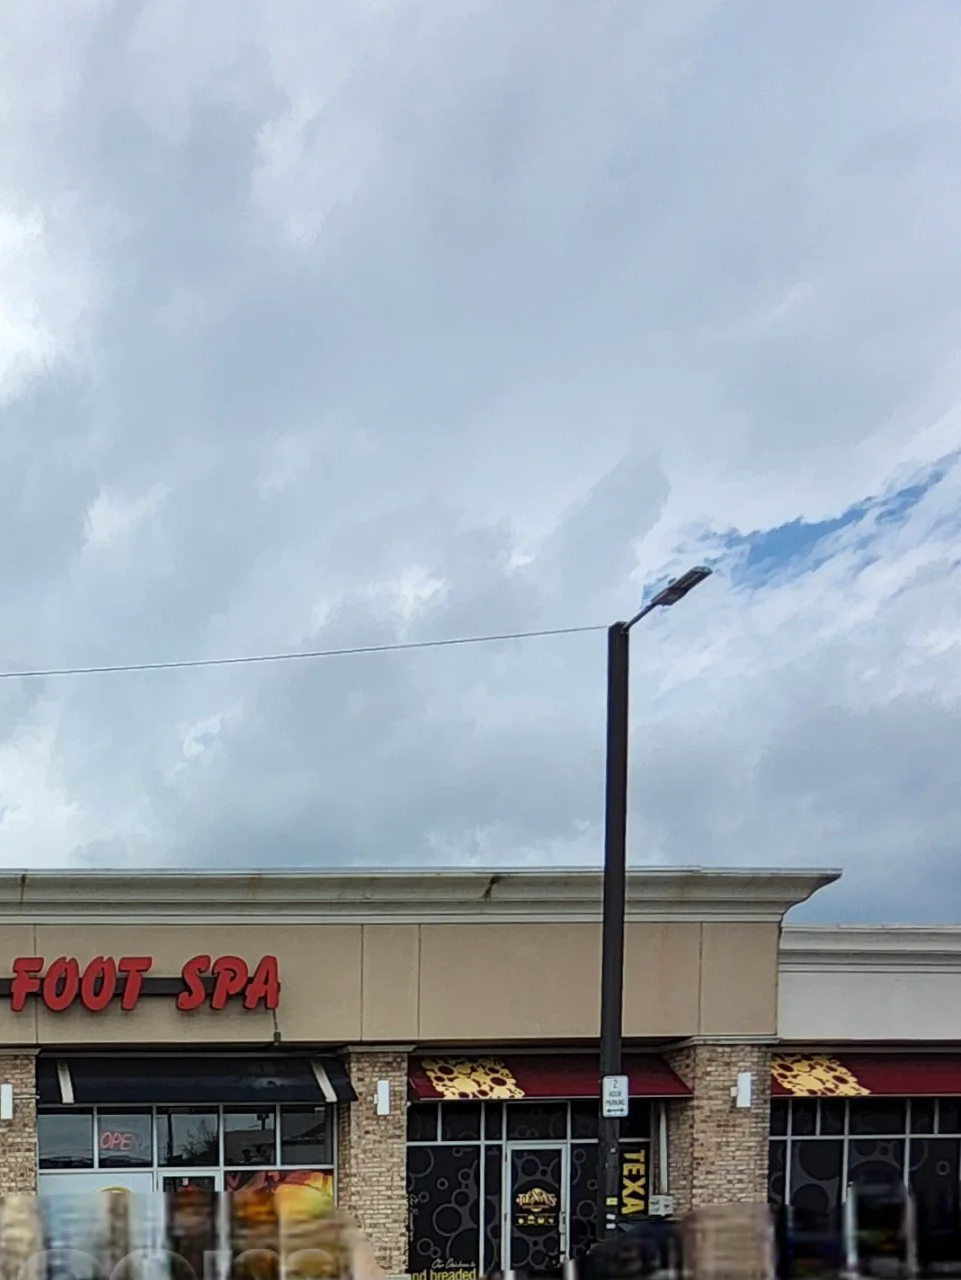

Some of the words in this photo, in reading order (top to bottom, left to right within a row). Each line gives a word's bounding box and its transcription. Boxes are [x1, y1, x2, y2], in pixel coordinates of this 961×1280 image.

[10, 956, 152, 1012] FOOT
[176, 954, 280, 1011] SPA
[613, 1079, 618, 1089] 2
[621, 1150, 646, 1215] TEXA
